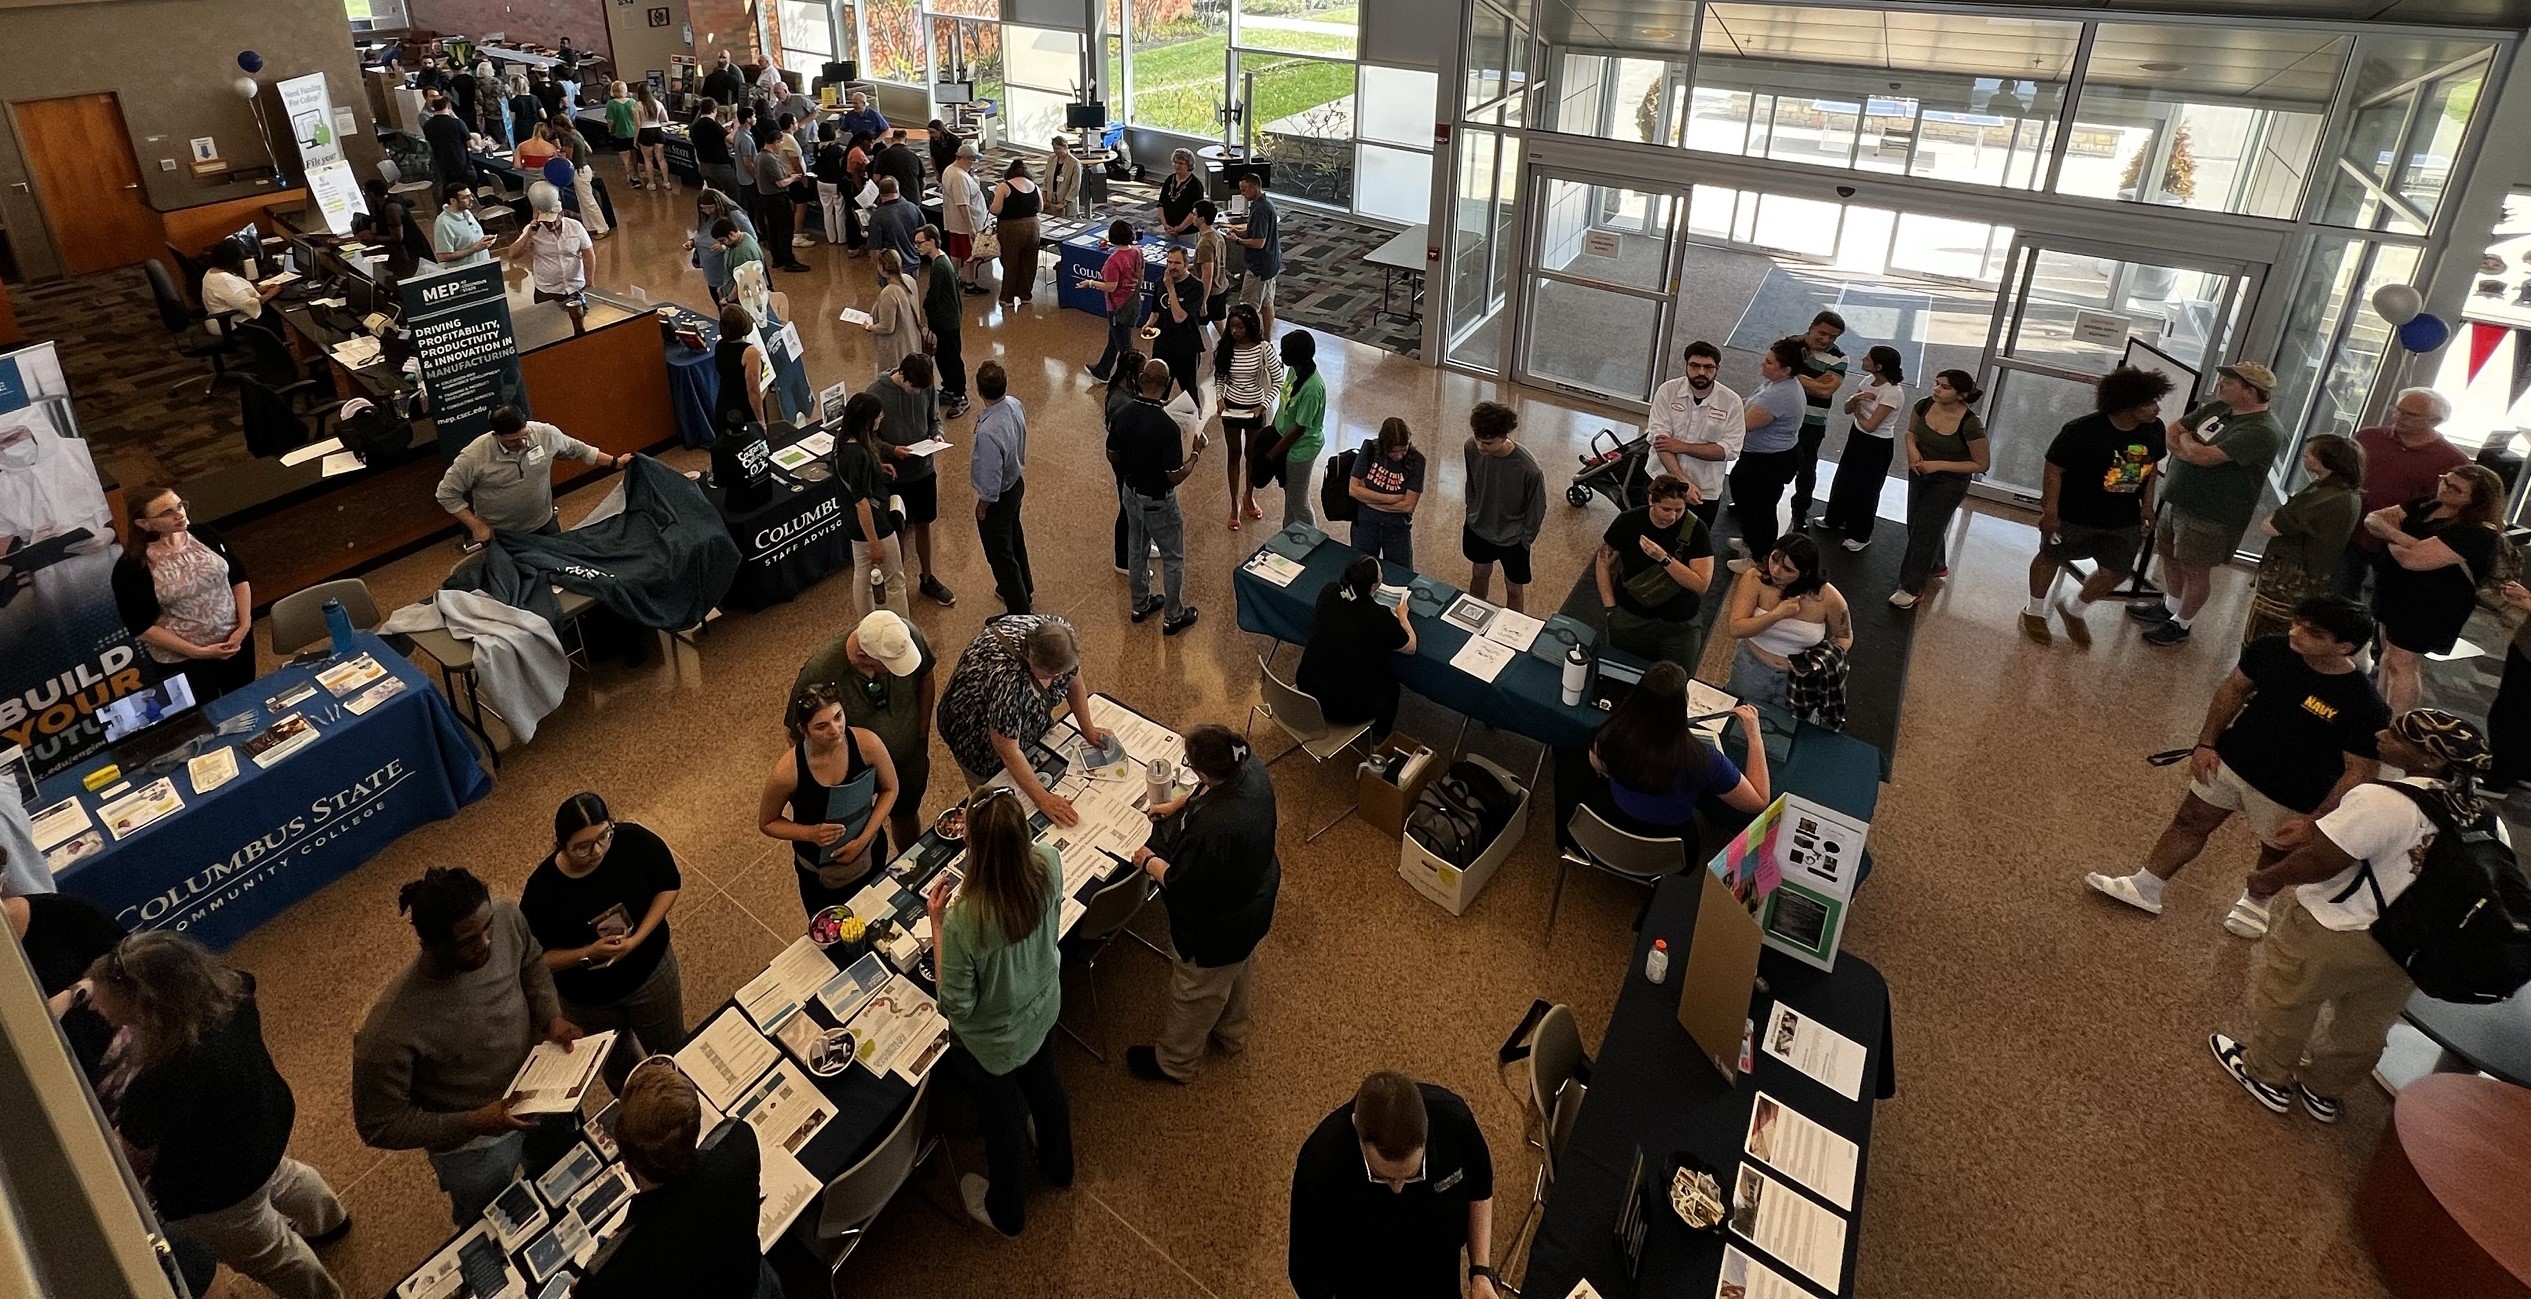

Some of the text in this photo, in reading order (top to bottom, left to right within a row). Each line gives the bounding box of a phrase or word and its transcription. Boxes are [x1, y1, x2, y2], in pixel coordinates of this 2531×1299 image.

[422, 282, 460, 302] MEP
[415, 318, 462, 338] DRIVING
[418, 320, 500, 348] PROFITABILITY,
[421, 330, 499, 358] PRODUCTIVITY
[423, 336, 513, 369] & INNOVATION IN
[426, 346, 516, 380] MANUFACTURING
[764, 543, 799, 566] STAFF
[0, 645, 134, 730] BUILD
[2, 668, 143, 749] YOUR
[2304, 695, 2338, 718] NAVY
[115, 758, 403, 934] COLUMBUS STATE
[176, 801, 386, 932] OMMUNITY COLLEGE
